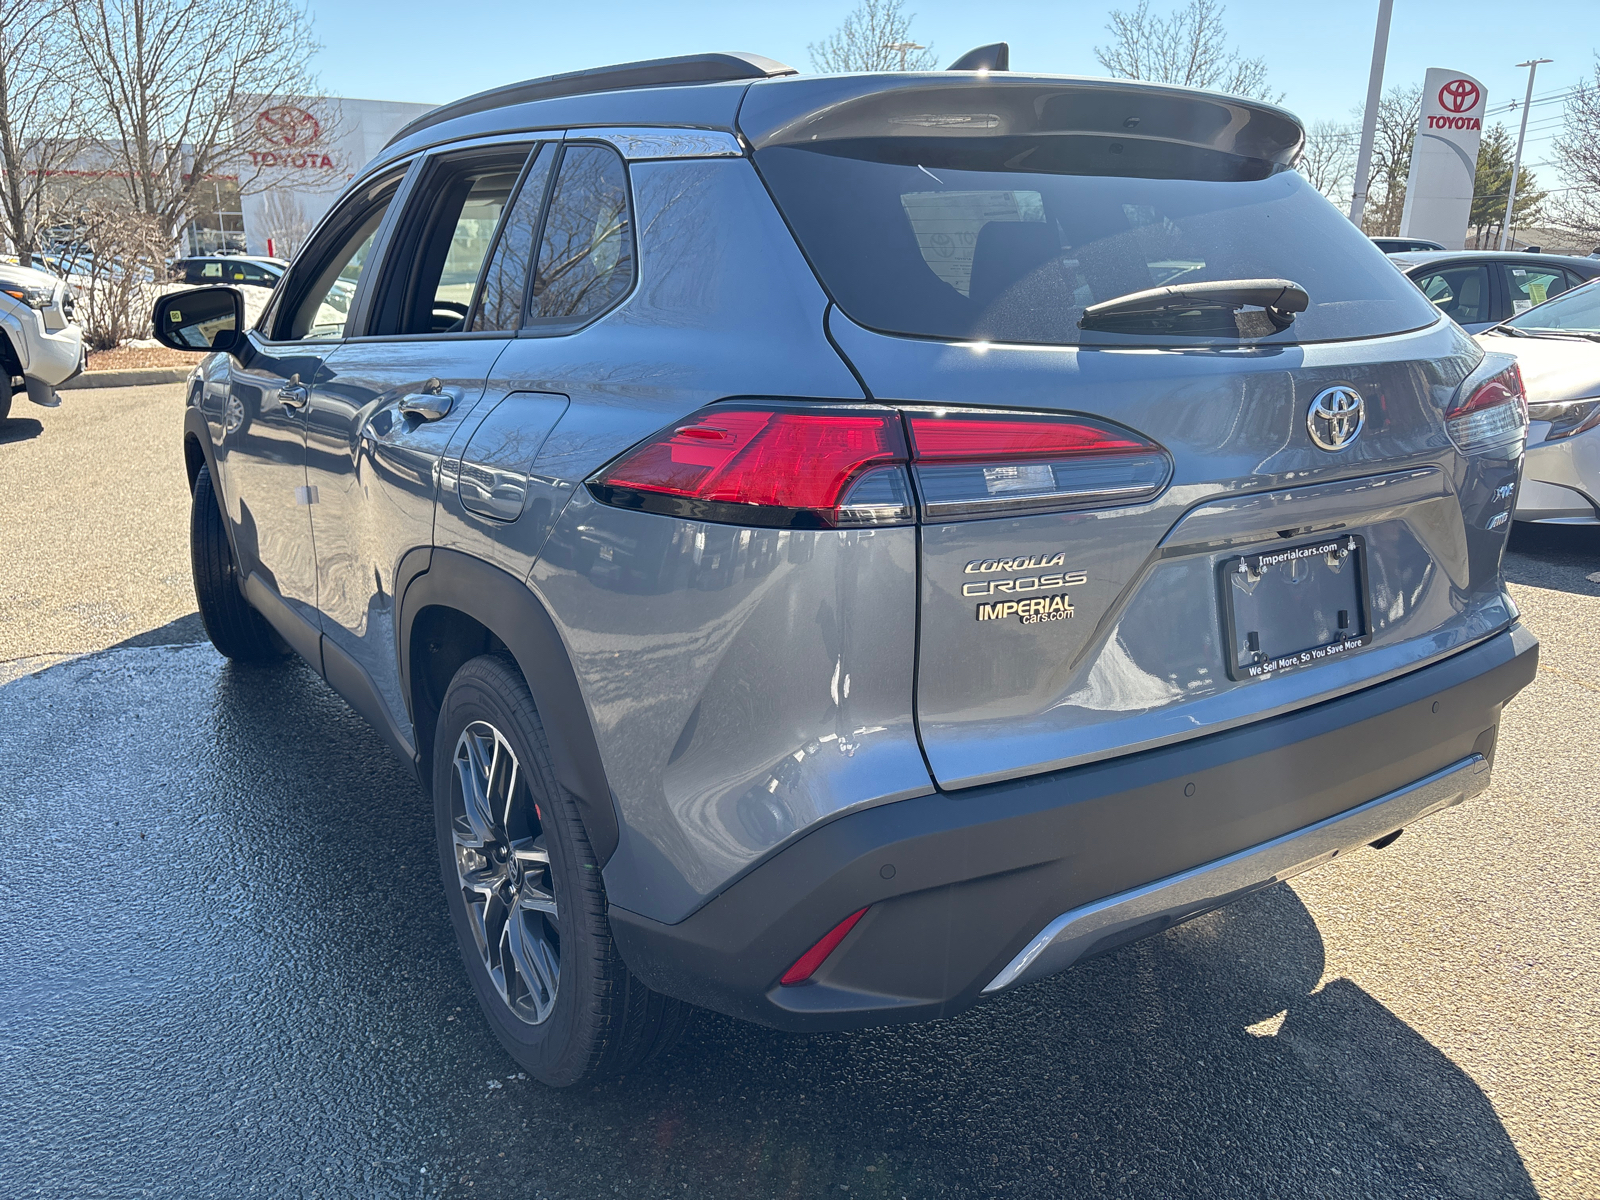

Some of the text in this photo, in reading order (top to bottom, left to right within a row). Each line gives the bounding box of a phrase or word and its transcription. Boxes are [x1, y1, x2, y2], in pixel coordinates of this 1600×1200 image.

[1427, 116, 1481, 131] TOYOTA
[249, 152, 334, 169] TOYOTA
[963, 552, 1066, 574] COROLLA
[1258, 543, 1338, 565] Imperialcars.com
[962, 569, 1088, 597] CROSS
[977, 594, 1075, 621] IMPERIAL
[1021, 609, 1074, 625] cars.com
[1249, 639, 1362, 677] We Sell More, So You Save More
